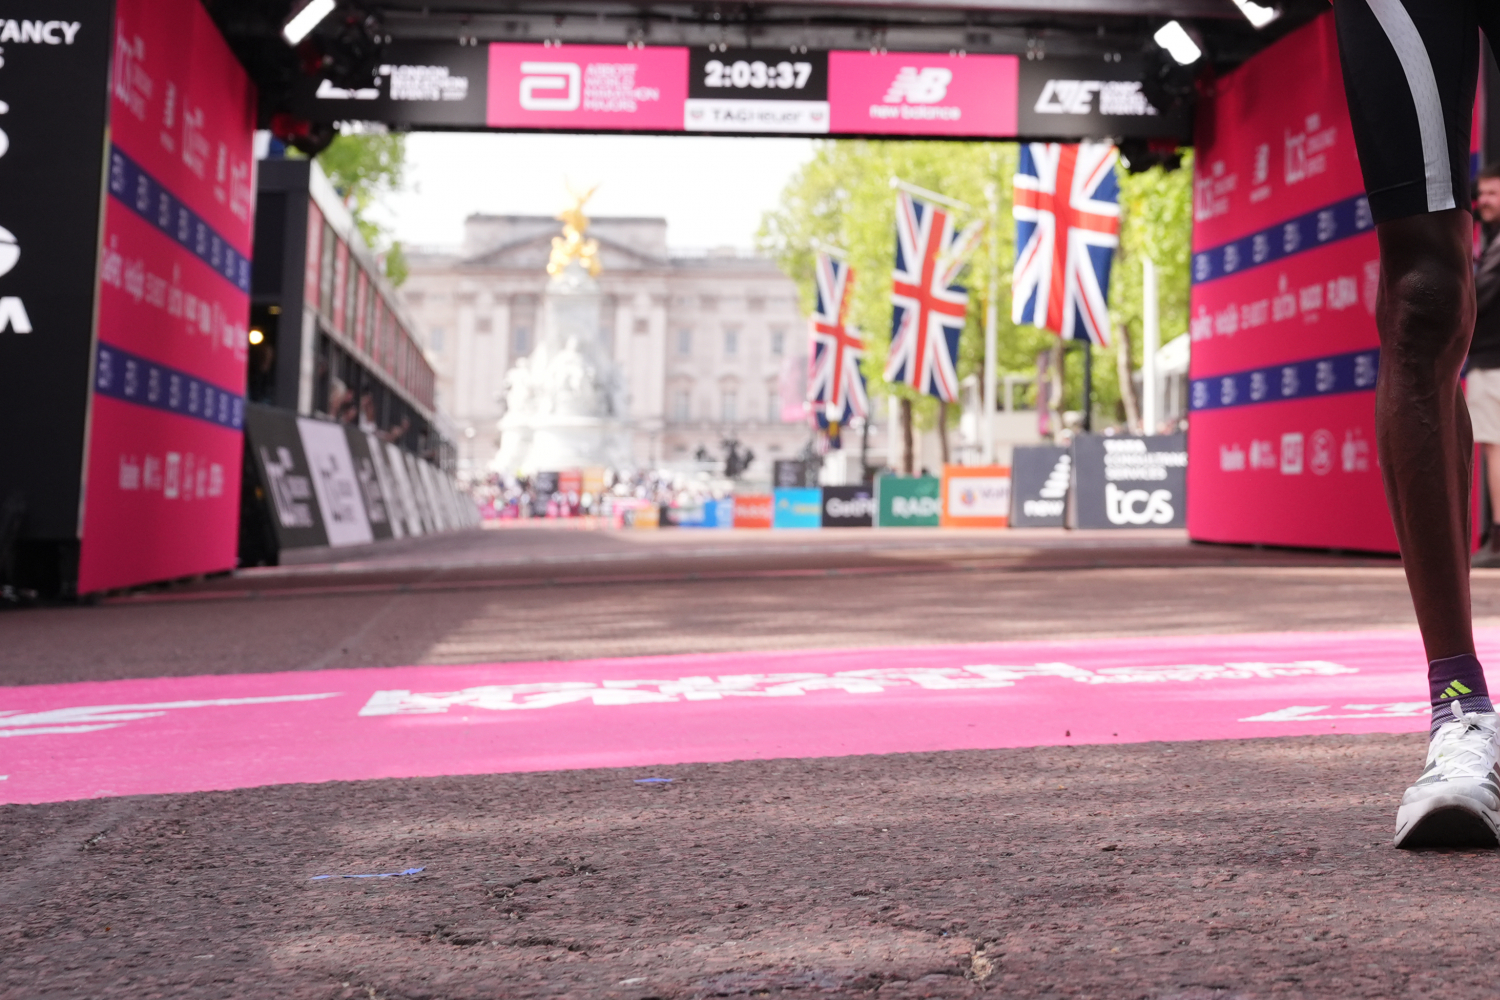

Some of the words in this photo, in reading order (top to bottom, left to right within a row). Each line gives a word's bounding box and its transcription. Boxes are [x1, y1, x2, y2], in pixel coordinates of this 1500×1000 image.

[704, 61, 813, 89] 2:03:37
[869, 105, 899, 119] new
[902, 104, 961, 121] balance
[1105, 482, 1174, 525] tcs
